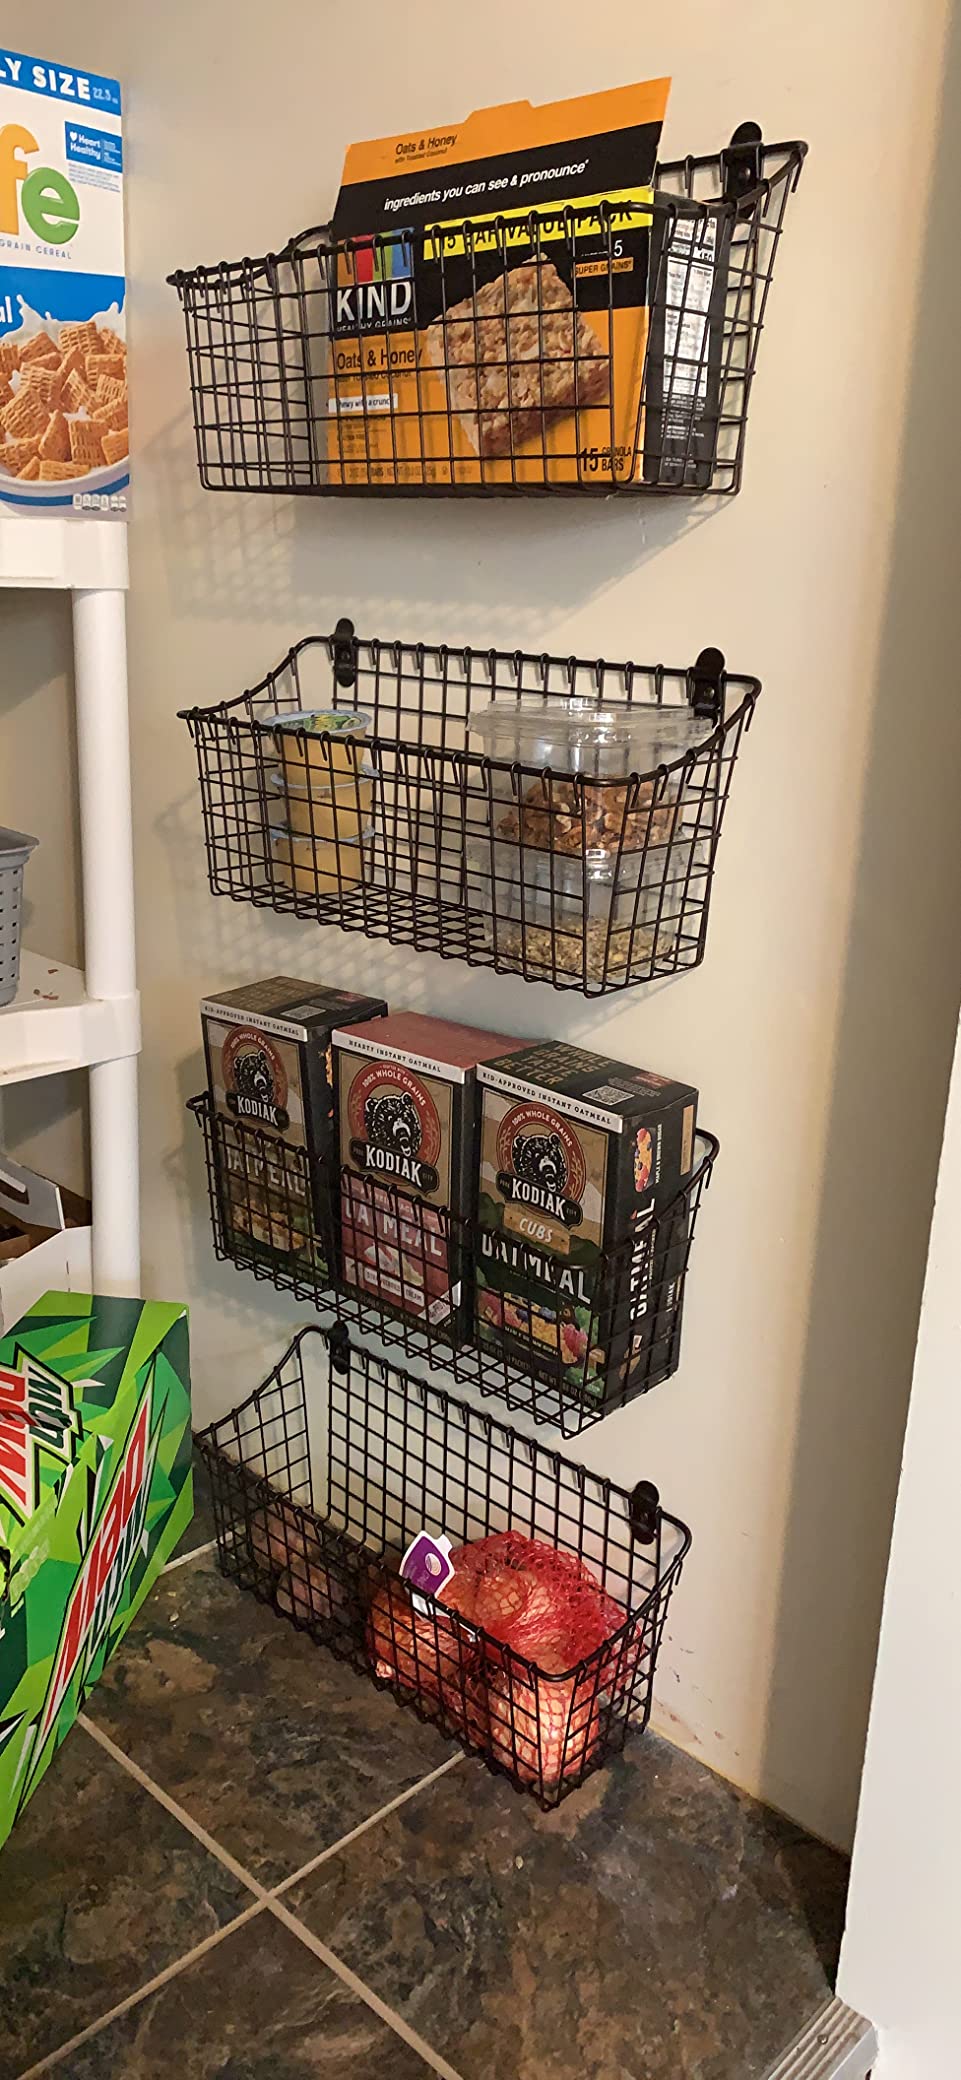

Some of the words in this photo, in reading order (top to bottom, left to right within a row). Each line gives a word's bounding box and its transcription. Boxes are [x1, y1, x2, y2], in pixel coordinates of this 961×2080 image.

[32, 65, 91, 101] SIZE
[395, 143, 416, 155] Oats
[427, 134, 458, 149] Honey
[383, 190, 441, 212] ingredients
[442, 186, 464, 203] you
[464, 181, 486, 196] can
[487, 176, 509, 191] see
[509, 174, 518, 187] &
[35, 246, 72, 260] CEREAL
[613, 239, 624, 258] 5
[336, 280, 412, 323] KIND
[336, 352, 362, 370] Oats
[367, 349, 377, 367] &
[581, 447, 599, 472] 15
[376, 1047, 407, 1062] INSTANT
[408, 1057, 441, 1073] OATMEAL
[494, 1058, 564, 1085] BETTER
[375, 1069, 402, 1081] WHOLE
[402, 1075, 427, 1107] GRAINS
[482, 1071, 536, 1097] KID-APPROVED
[538, 1090, 572, 1111] INSTANT
[574, 1106, 612, 1125] OATMEAL
[236, 1095, 279, 1127] KODIAK
[511, 1112, 526, 1127] 100%
[525, 1110, 550, 1122] WHOLE
[550, 1118, 573, 1148] GRAINS
[365, 1143, 423, 1188] KODIAK
[510, 1177, 567, 1221] KODIAK
[519, 1217, 553, 1243] CUBS
